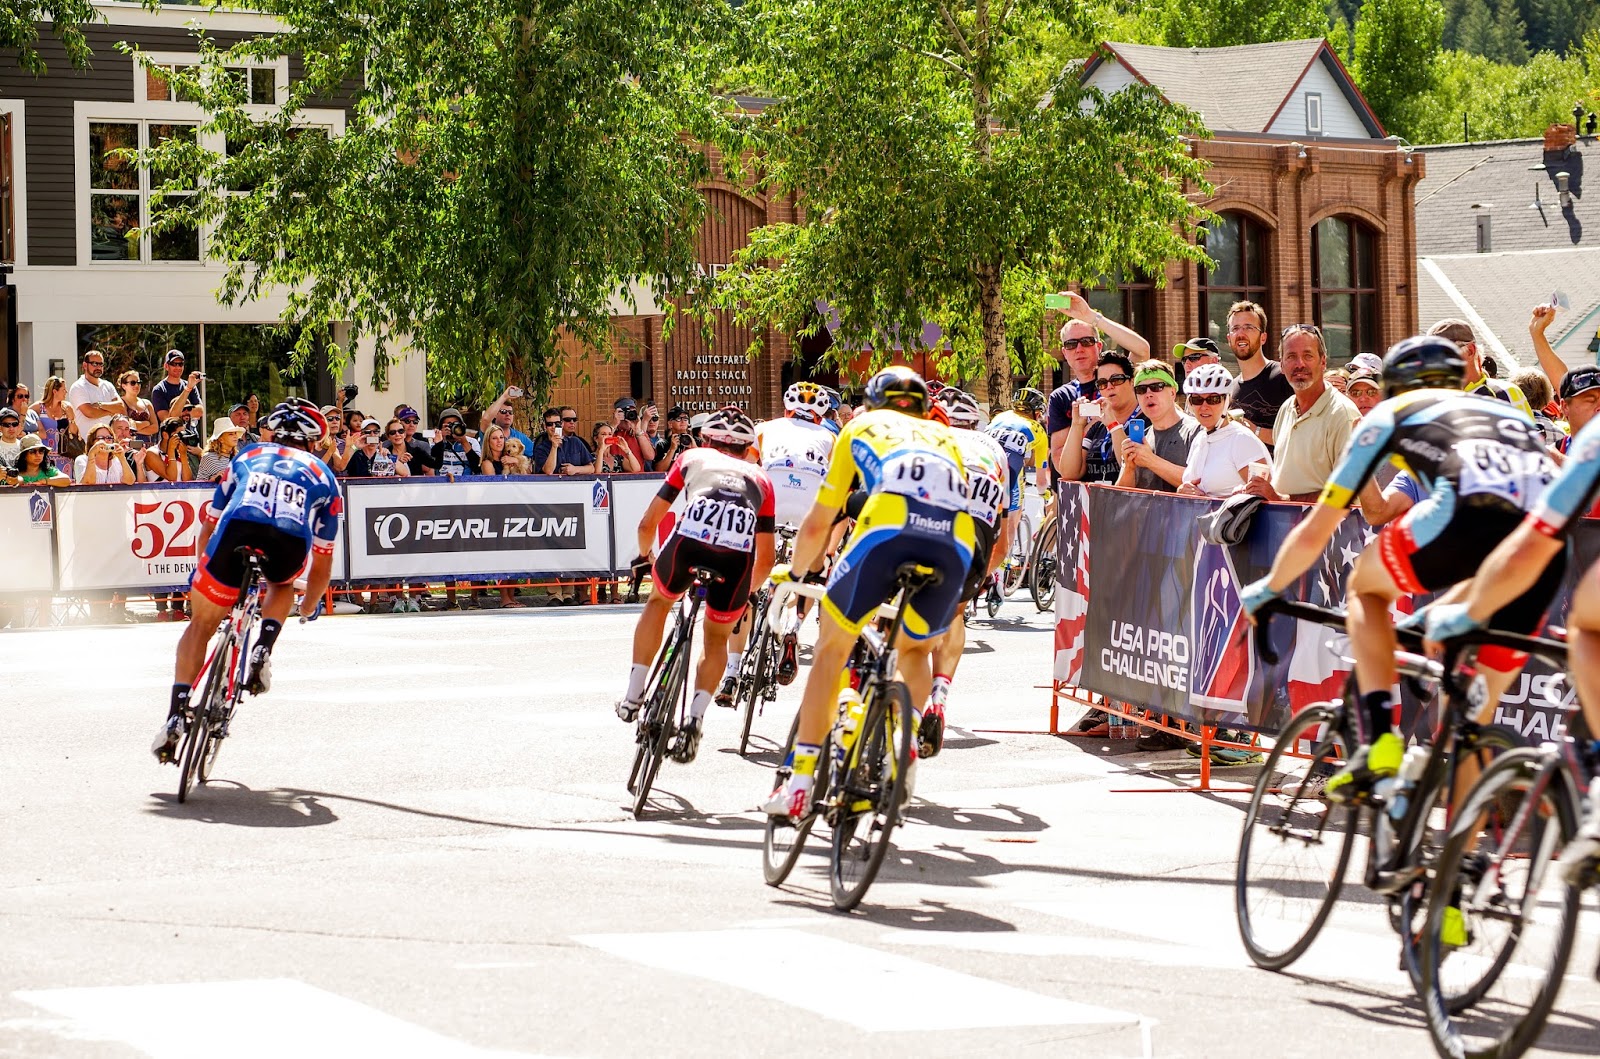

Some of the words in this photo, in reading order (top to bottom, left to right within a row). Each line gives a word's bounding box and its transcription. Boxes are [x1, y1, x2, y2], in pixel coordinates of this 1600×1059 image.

[696, 355, 720, 364] AUTO
[722, 355, 750, 364] PARTS
[677, 370, 708, 379] RADIO
[715, 370, 747, 379] SHACK
[671, 385, 701, 395] SIGHT
[707, 386, 713, 394] &
[719, 385, 752, 395] SOUND
[676, 401, 717, 410] KITCHEN
[896, 456, 926, 482] 16
[971, 476, 1000, 510] 142
[414, 518, 498, 541] PEARL
[726, 509, 755, 536] 132
[909, 513, 952, 532] Tinkoff
[154, 564, 171, 574] THE
[1110, 619, 1145, 655] USA
[1147, 628, 1189, 664] PRO
[1101, 647, 1189, 693] CHALLENGE
